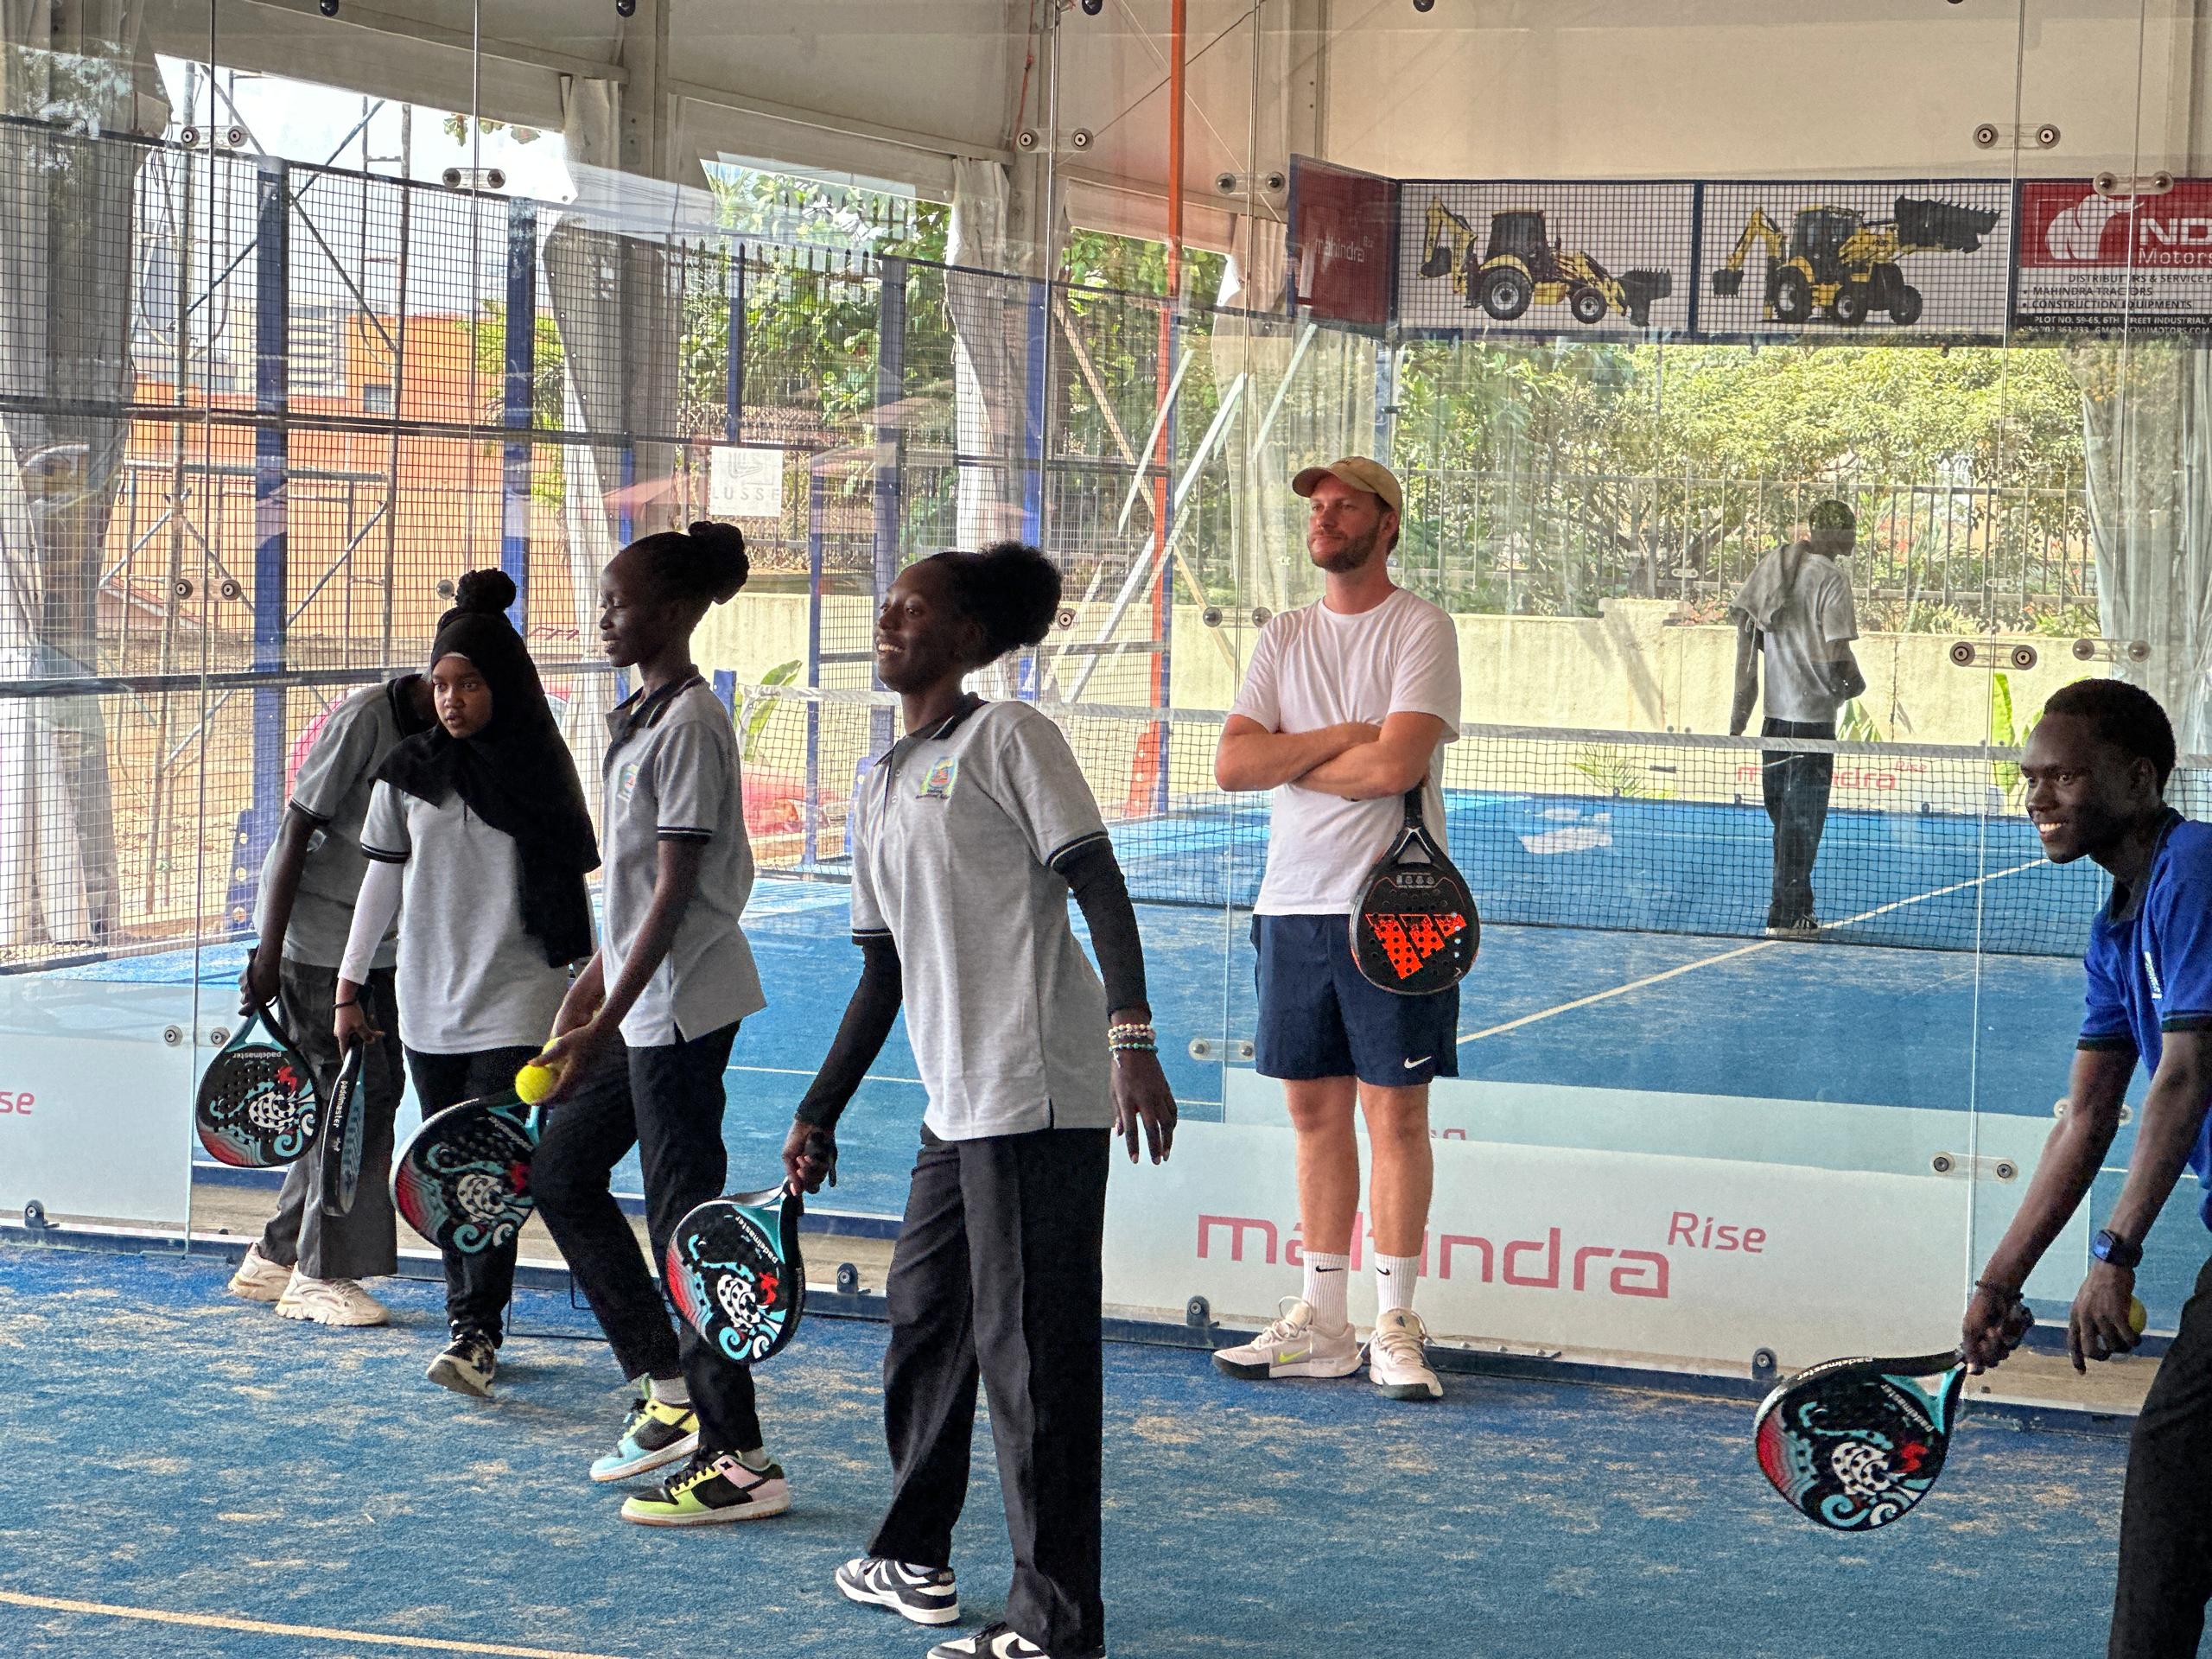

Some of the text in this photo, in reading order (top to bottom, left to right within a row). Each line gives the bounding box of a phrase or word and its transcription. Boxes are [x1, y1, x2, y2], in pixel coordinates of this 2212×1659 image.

[1314, 236, 1364, 263] mahindra
[2069, 274, 2146, 283] DISTRIBUTRS
[2160, 275, 2203, 283] SERVICE
[2032, 300, 2117, 308] CONSTRUCTION
[2033, 287, 2153, 296] MAHINDRA TRACORS
[232, 1051, 283, 1060] padelmaster
[332, 1080, 349, 1129] padelmaster
[734, 1215, 779, 1264] padelmaster
[1667, 1211, 1767, 1254] Rise
[1796, 1357, 1873, 1381] padelmaster
[1880, 1383, 1936, 1433] padelmaster
